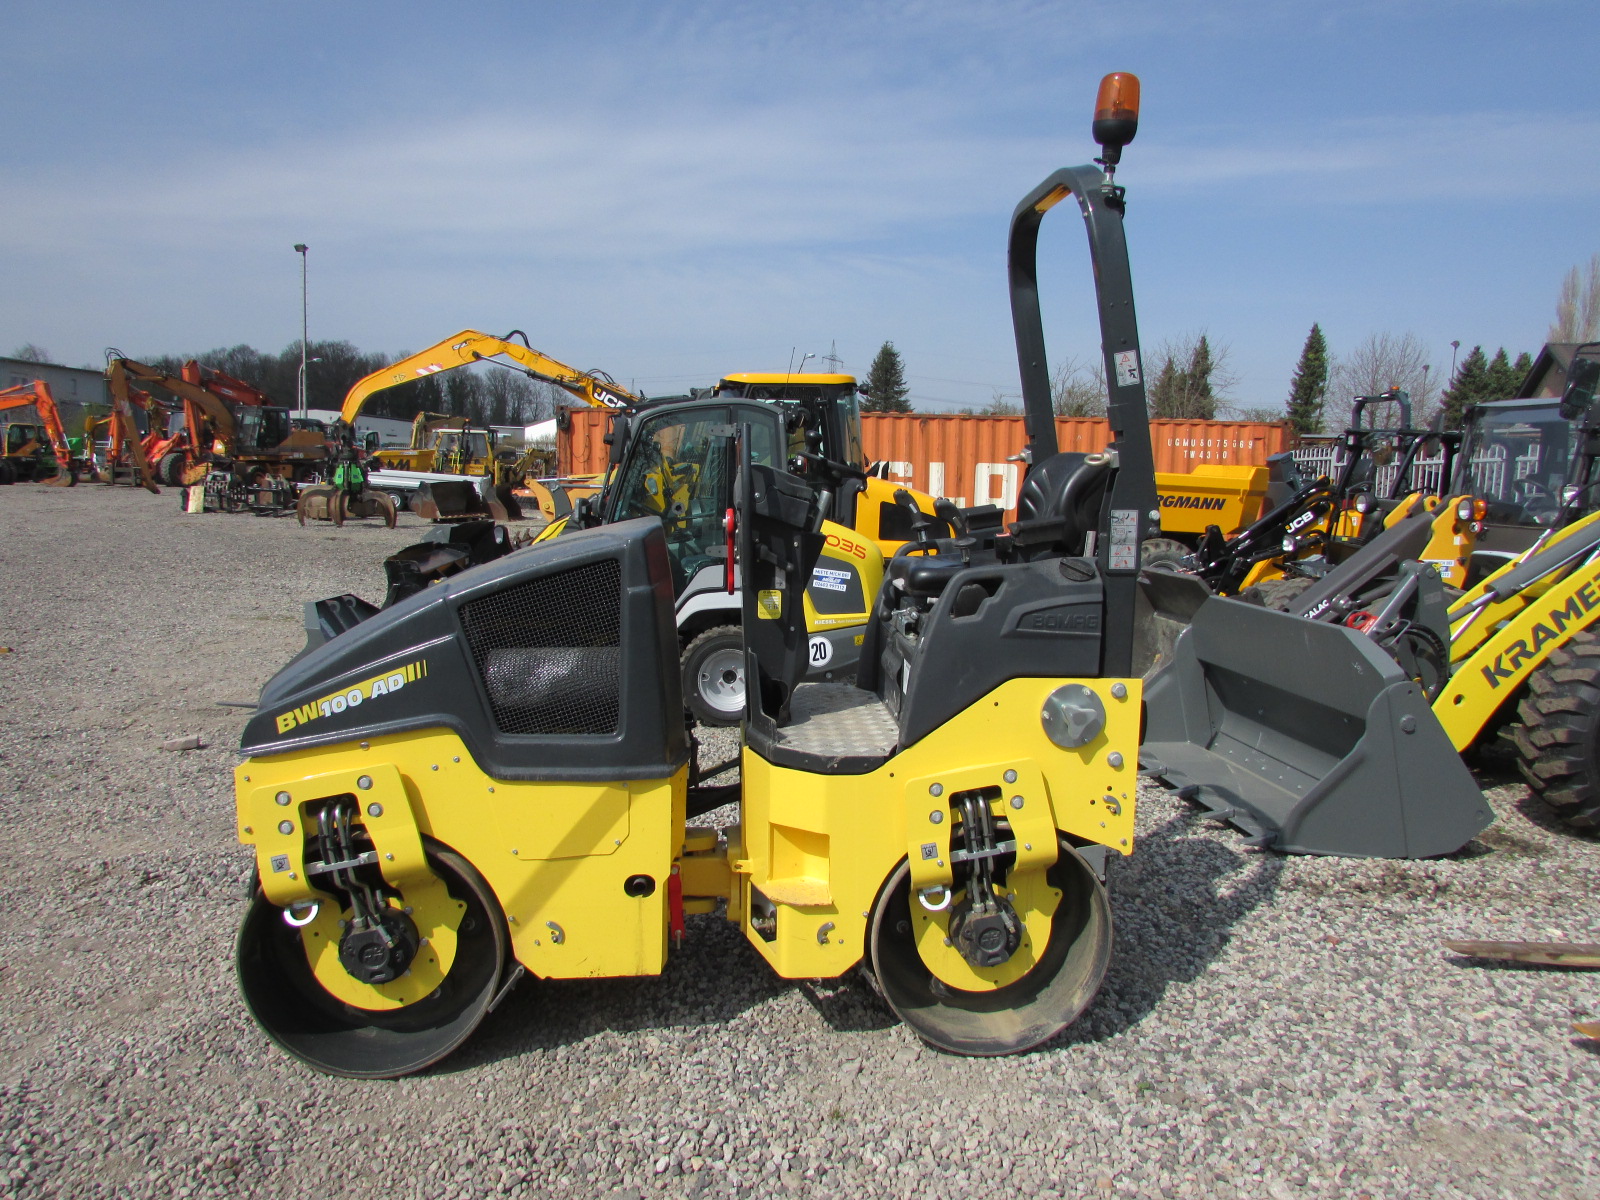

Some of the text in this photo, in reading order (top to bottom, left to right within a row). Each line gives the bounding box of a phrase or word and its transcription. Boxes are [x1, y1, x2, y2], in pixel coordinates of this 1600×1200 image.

[1285, 511, 1314, 534] JCB
[1480, 572, 1600, 690] KRAME
[811, 641, 827, 662] 20
[371, 673, 405, 700] AD
